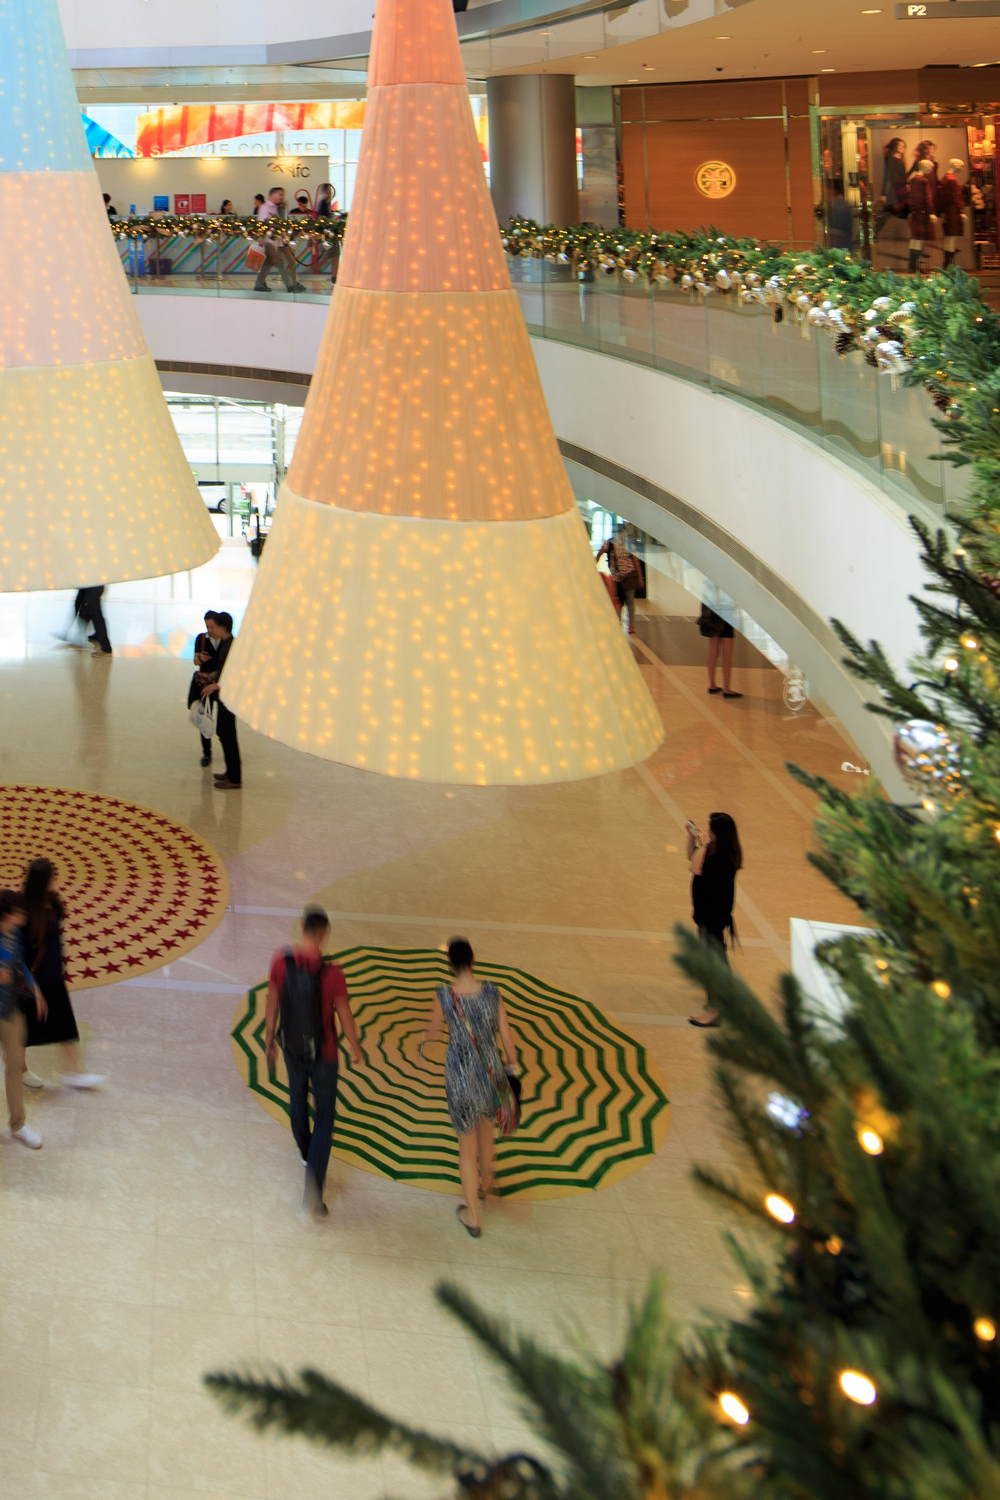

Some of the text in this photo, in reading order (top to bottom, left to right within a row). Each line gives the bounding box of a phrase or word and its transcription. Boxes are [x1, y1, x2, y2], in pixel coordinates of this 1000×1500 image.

[907, 4, 927, 16] P2
[149, 144, 229, 158] SERVICE
[238, 143, 330, 156] COUNTER
[292, 164, 310, 177] ifc
